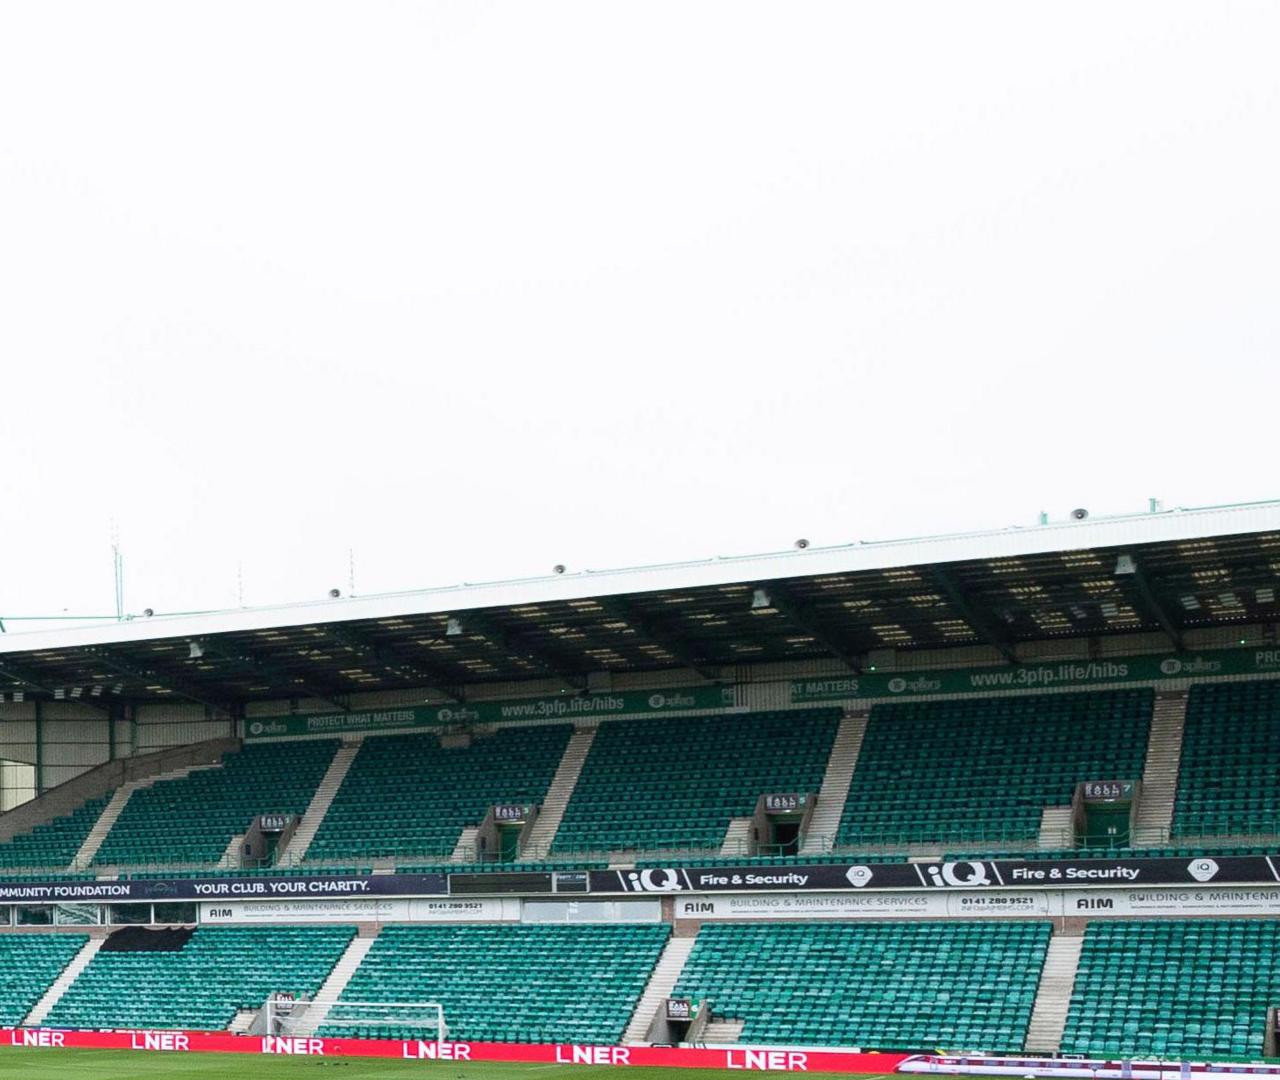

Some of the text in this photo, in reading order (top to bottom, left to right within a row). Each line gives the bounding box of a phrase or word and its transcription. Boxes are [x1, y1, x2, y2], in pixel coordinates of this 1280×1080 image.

[970, 662, 1129, 688] www.3pfp.life/hibs
[806, 679, 859, 693] MATTERS
[502, 696, 625, 717] www.3pfp.life/hibs
[308, 714, 345, 728] PROTECT
[346, 712, 372, 724] WHAT
[373, 710, 415, 723] MATTERS
[630, 868, 683, 891] iQ
[700, 872, 809, 887] Fire & Security
[927, 861, 991, 886] iQ
[1012, 866, 1140, 882] Fire & Security
[54, 885, 130, 897] FOUNDATION
[194, 880, 370, 894] YOUR CLUB. YOUR CHARITY.
[729, 896, 928, 908] BUILDING & MAINTENANCE SERVICES
[961, 897, 1034, 906] 0141 280 9521
[1076, 898, 1114, 910] AIM
[1129, 892, 1189, 903] BUILDING
[1194, 892, 1204, 902] &
[209, 908, 233, 918] AIM
[243, 903, 281, 912] BUILDING
[293, 902, 351, 911] MAINTENANCE
[353, 902, 393, 911] SERVICES
[685, 902, 715, 914] AIM
[11, 1029, 65, 1048] LNER
[132, 1032, 190, 1051] LNER
[262, 1034, 324, 1056] LNER
[402, 1039, 471, 1061] LNER
[556, 1044, 631, 1065] LNER
[726, 1049, 807, 1072] LNER
